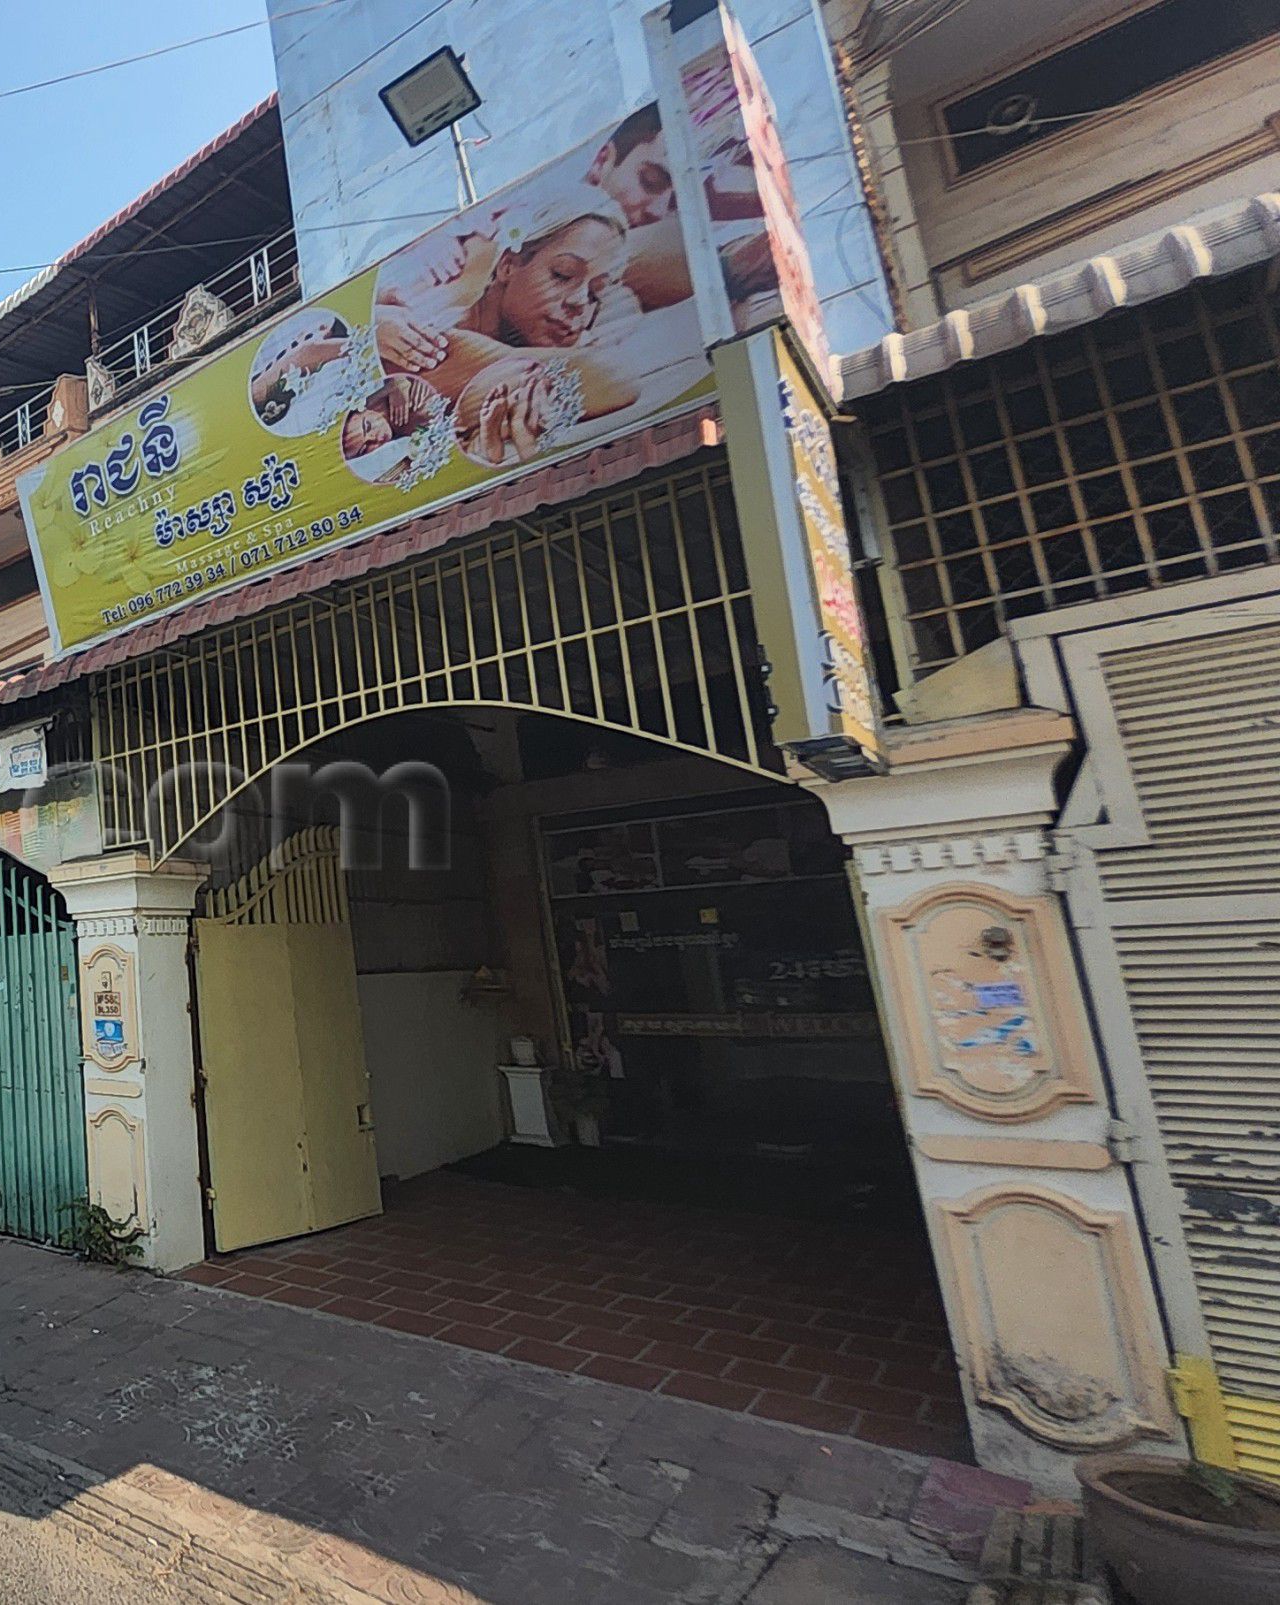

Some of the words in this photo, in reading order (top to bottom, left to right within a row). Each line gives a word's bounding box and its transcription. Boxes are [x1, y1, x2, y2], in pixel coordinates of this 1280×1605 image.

[89, 483, 177, 536] Reachny
[102, 606, 127, 625] Tel:
[128, 593, 154, 614] 096
[155, 581, 183, 604] 772
[184, 571, 203, 591] 39
[205, 562, 226, 584] 34
[240, 544, 271, 568] 071
[274, 528, 307, 553] 712
[310, 516, 335, 539] 80
[337, 504, 362, 527] 34
[175, 541, 240, 575] Massage
[264, 518, 295, 536] Spa
